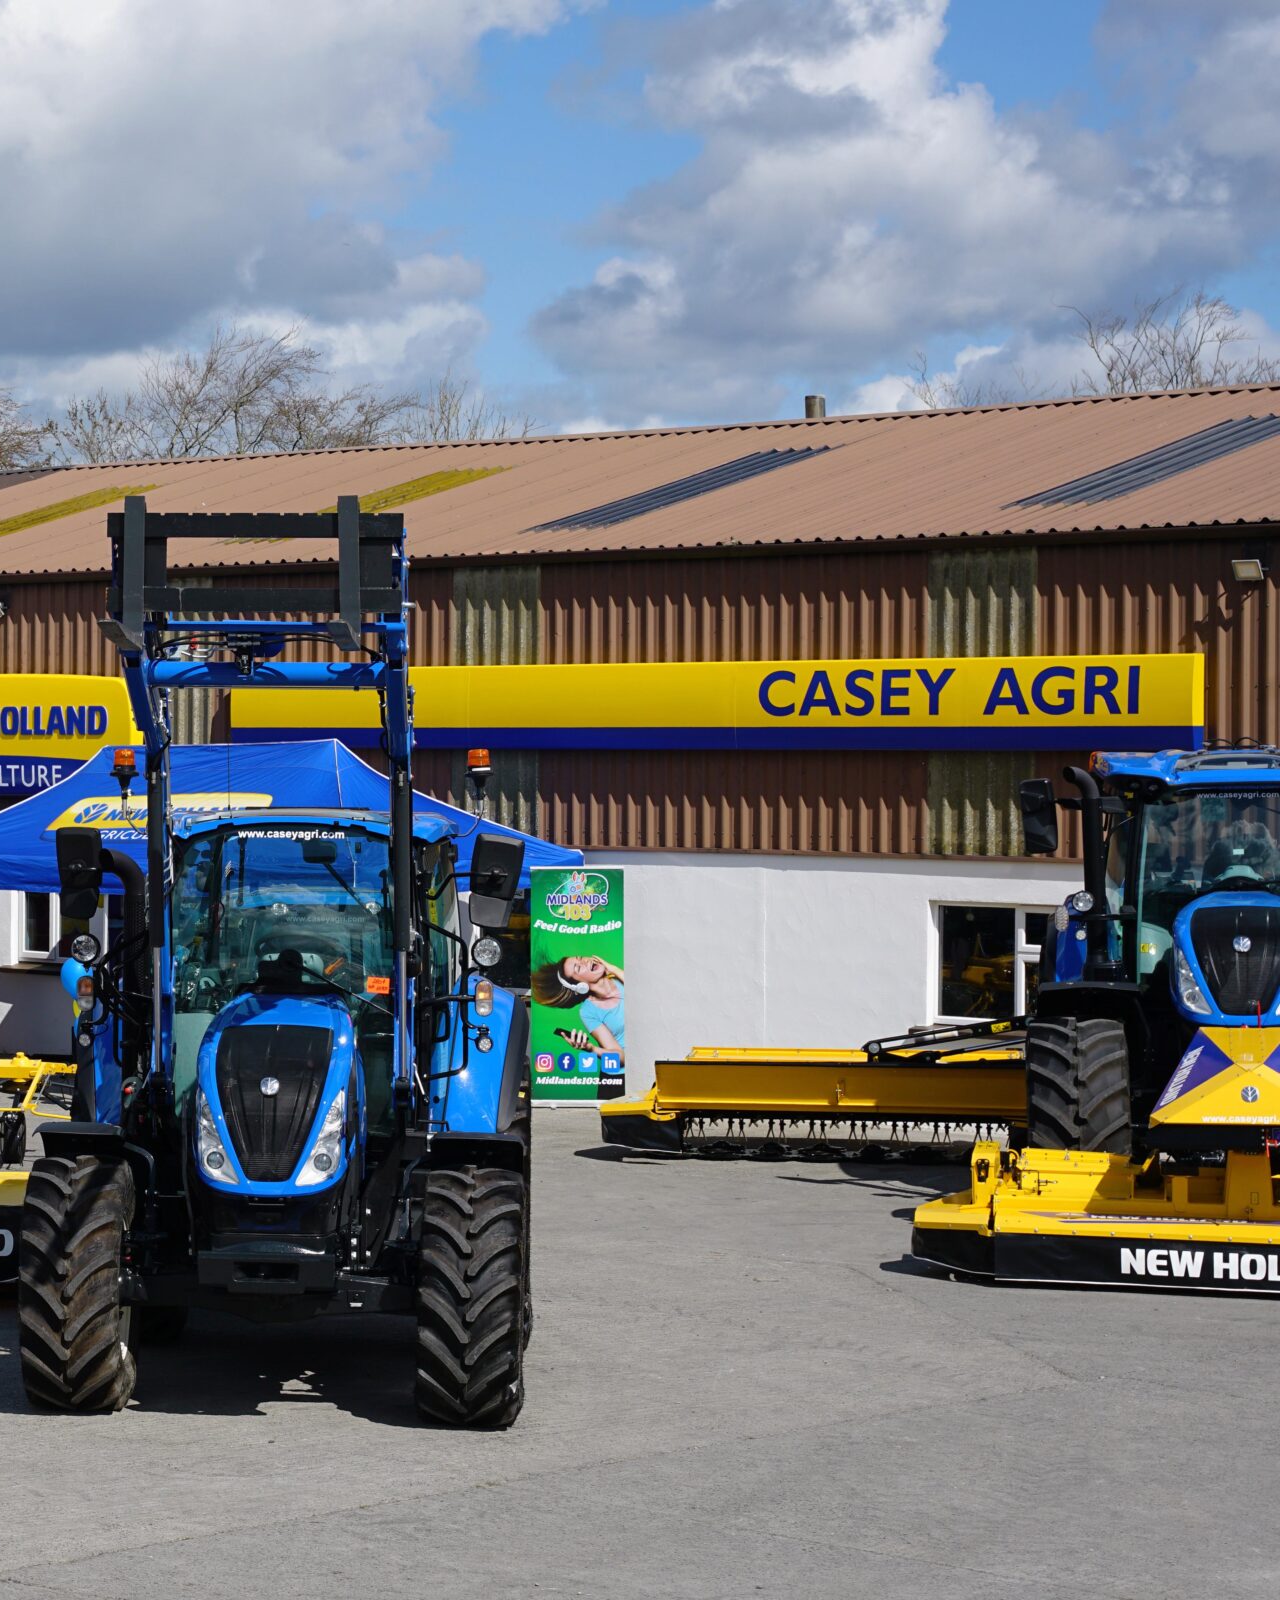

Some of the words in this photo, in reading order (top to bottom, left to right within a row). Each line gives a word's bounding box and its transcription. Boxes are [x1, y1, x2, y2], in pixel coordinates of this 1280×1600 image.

[758, 668, 956, 717] CASEY
[983, 665, 1141, 716] AGRI
[1196, 791, 1280, 799] www.caseyagri.com
[237, 829, 345, 840] www.caseyagri.com
[546, 893, 608, 906] MIDLANDS
[564, 904, 591, 920] 103
[533, 919, 558, 932] Feel
[558, 925, 588, 934] Good
[589, 920, 622, 934] Radio
[535, 1076, 623, 1085] Midlands103.com
[1120, 1247, 1205, 1278] NEW
